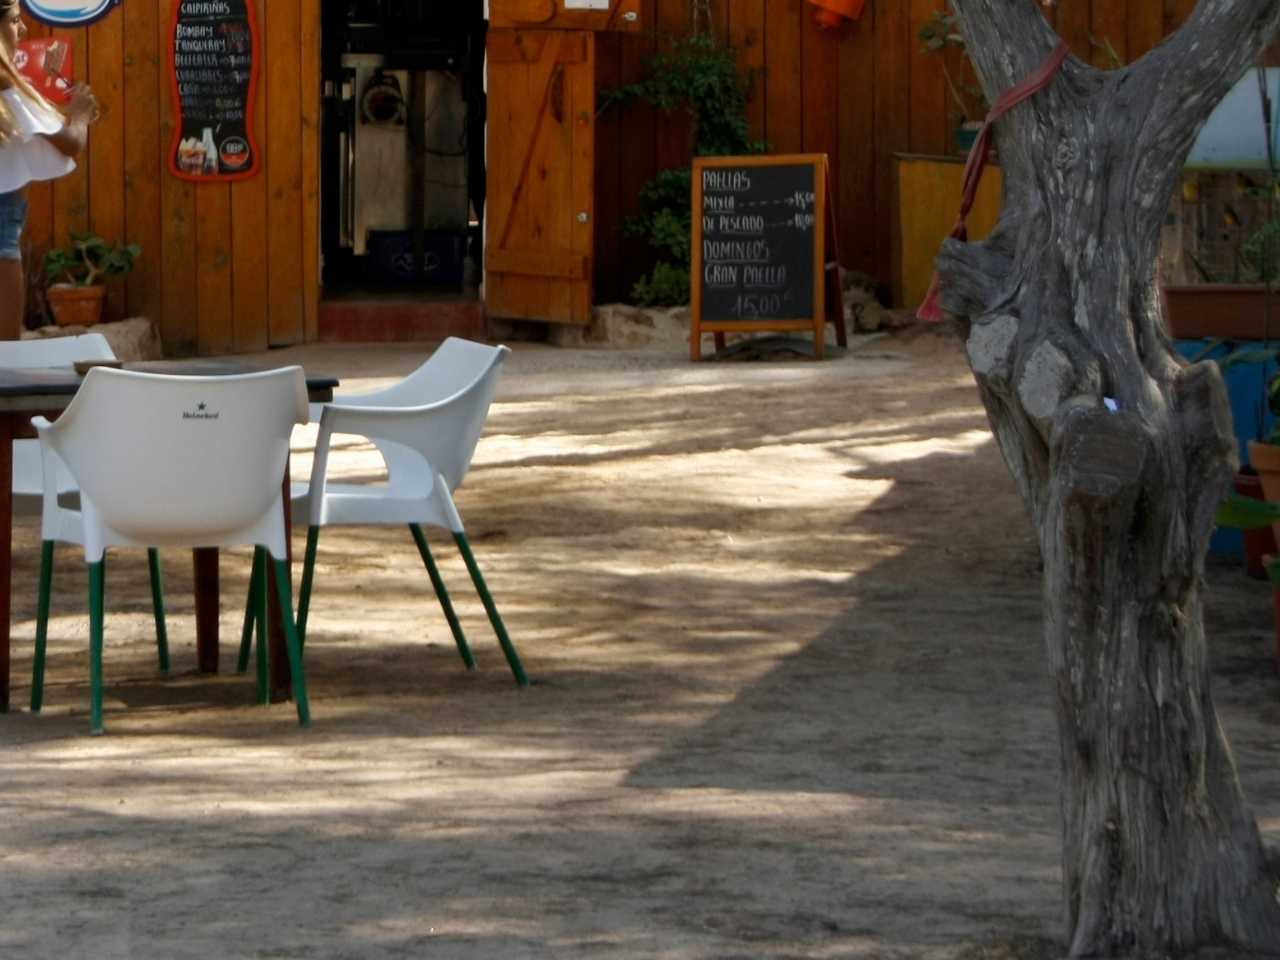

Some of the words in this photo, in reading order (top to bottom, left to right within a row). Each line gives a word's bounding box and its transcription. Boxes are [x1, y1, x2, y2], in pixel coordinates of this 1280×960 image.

[703, 170, 751, 191] PAELLAS
[719, 215, 764, 233] PESCADO
[704, 240, 770, 260] DOMINGOS
[705, 263, 737, 284] GRAN
[743, 265, 786, 284] PAELLA
